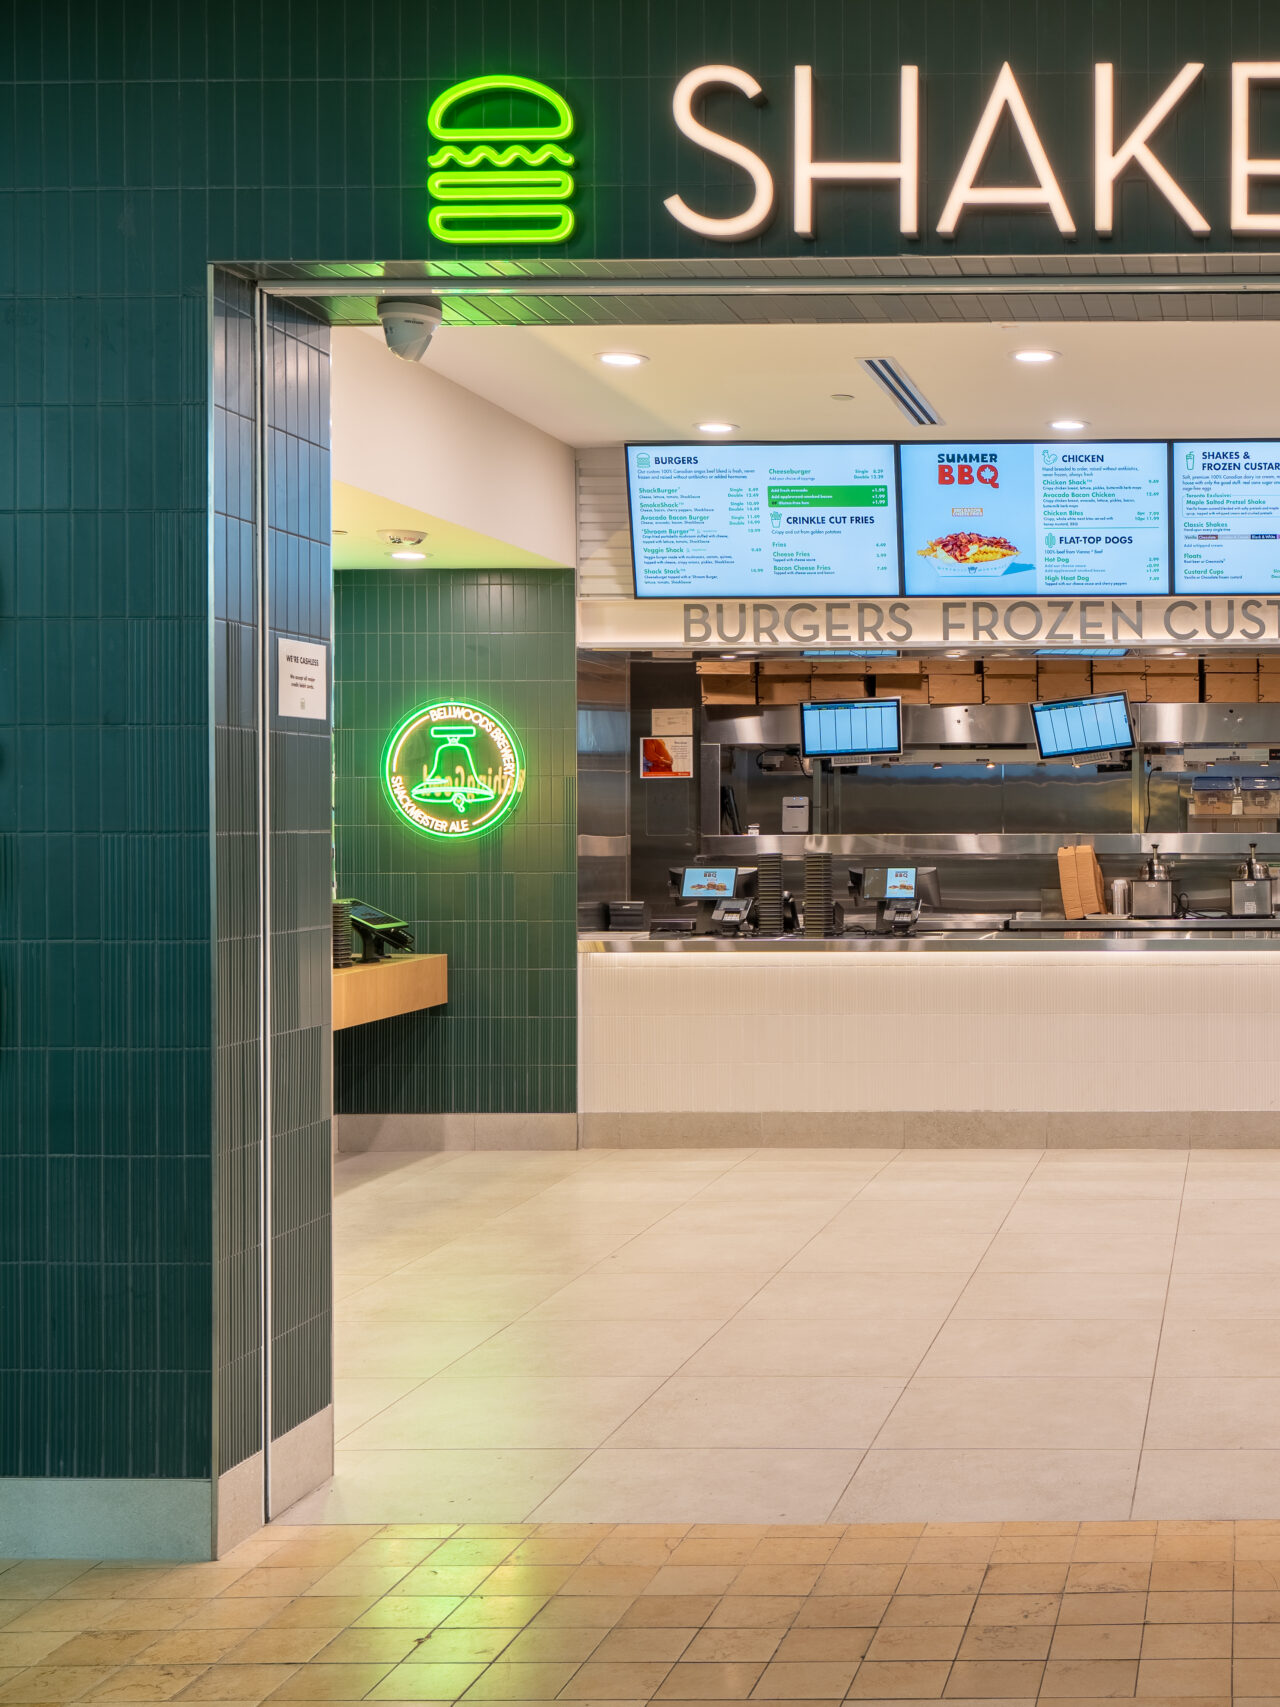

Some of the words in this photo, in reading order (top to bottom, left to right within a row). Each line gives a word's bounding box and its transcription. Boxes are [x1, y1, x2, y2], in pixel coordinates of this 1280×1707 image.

[938, 454, 997, 463] SUMMER
[1062, 454, 1104, 463] CHICKEN
[938, 464, 999, 488] BBQ
[850, 516, 874, 524] FRIES
[1060, 536, 1101, 544] FLAT-TOP
[1105, 536, 1133, 544] DOGS
[683, 601, 913, 642] BURGERS
[942, 600, 1143, 641] FROZEN
[429, 706, 495, 733] BELLWOODS
[490, 728, 515, 777] BREWERY
[391, 775, 448, 832] SHACKMEISTER
[449, 820, 469, 832] ALE
